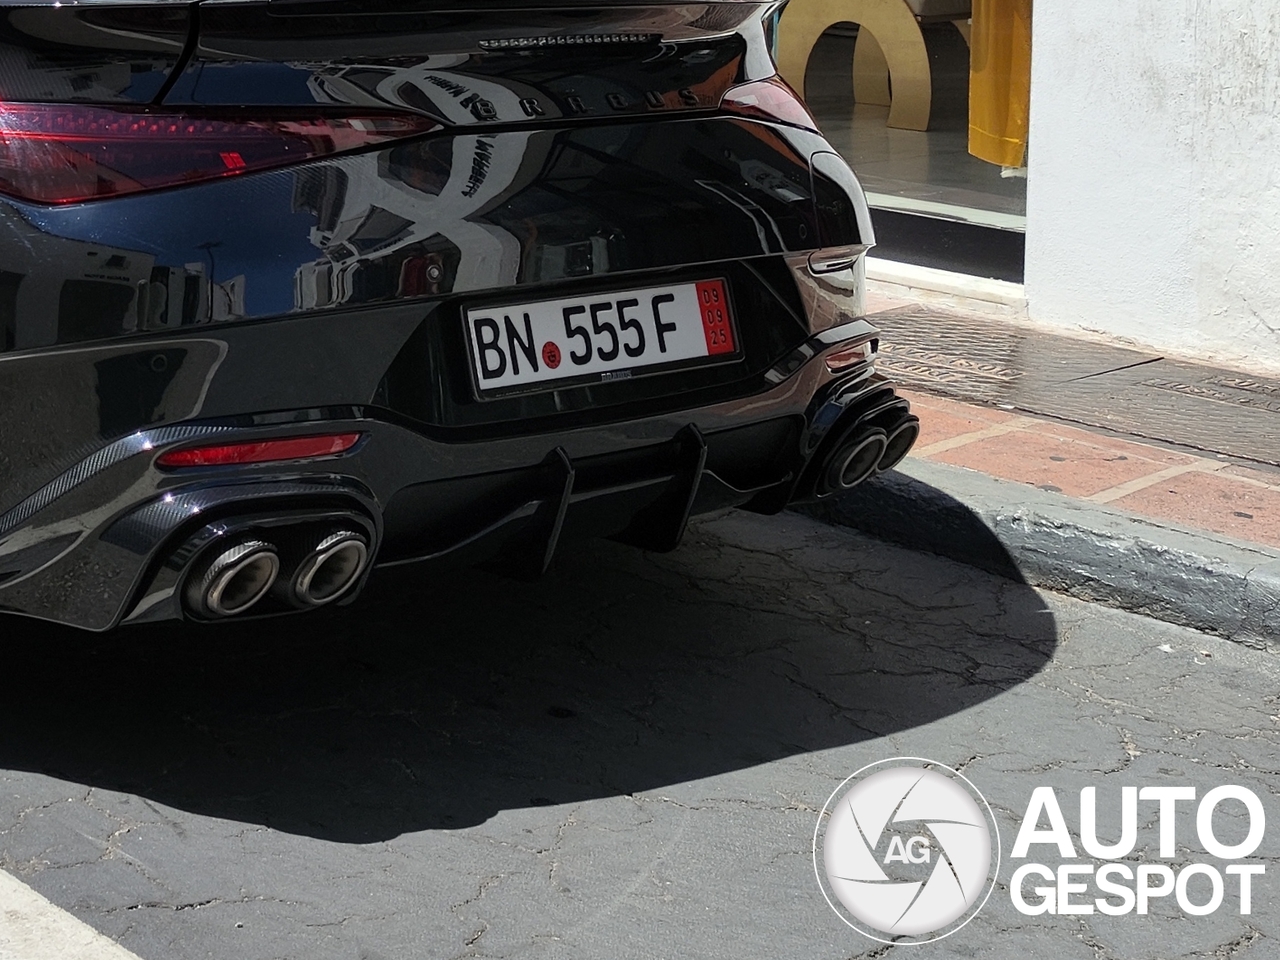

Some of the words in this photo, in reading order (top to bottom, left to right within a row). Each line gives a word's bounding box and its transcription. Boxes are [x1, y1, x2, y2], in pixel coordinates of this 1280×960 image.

[703, 288, 720, 304] 09
[707, 308, 724, 324] 09
[473, 312, 539, 380] BN
[562, 298, 646, 366] 555
[651, 293, 677, 354] F
[710, 329, 727, 346] 25
